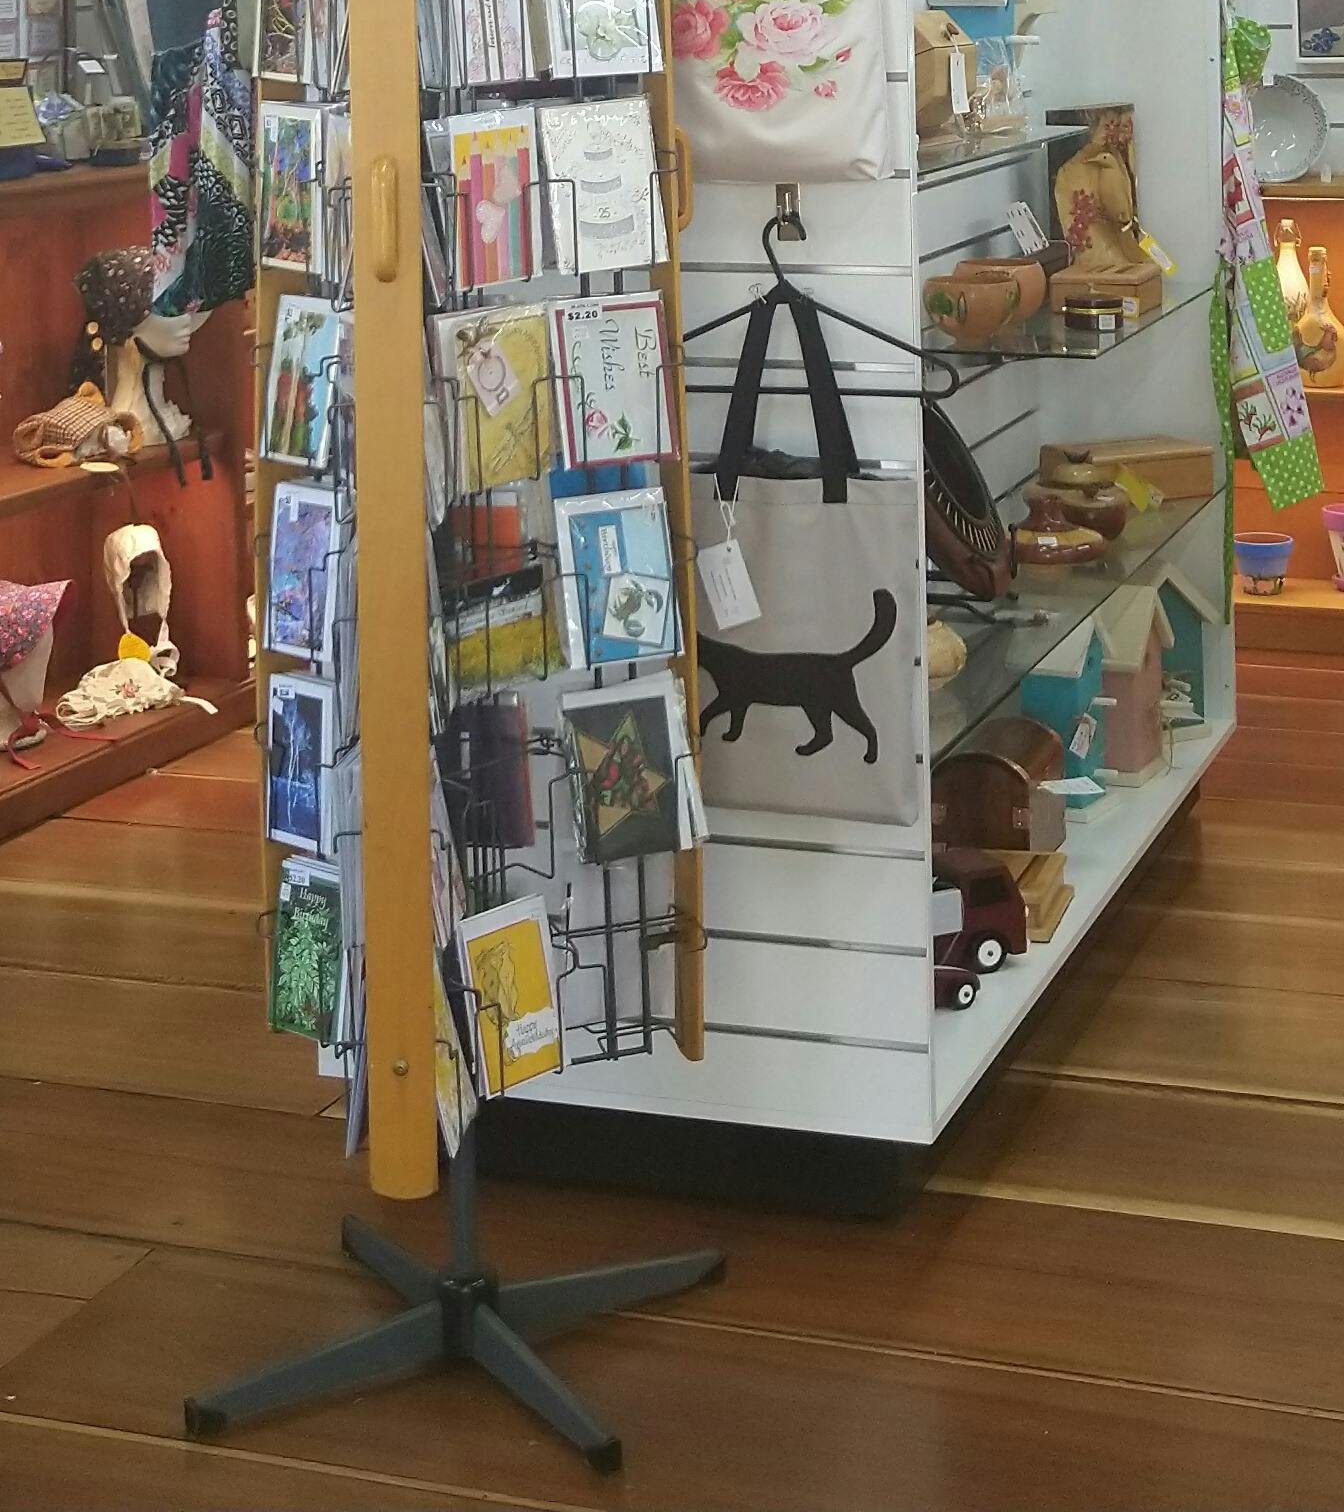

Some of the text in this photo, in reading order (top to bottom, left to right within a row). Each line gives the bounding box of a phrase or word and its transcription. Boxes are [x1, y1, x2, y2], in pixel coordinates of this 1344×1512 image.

[597, 207, 612, 218] 25
[567, 310, 598, 321] $2.20
[599, 318, 625, 391] Wishes
[634, 325, 657, 379] Best
[299, 887, 327, 910] Happy
[290, 906, 331, 932] Birthday
